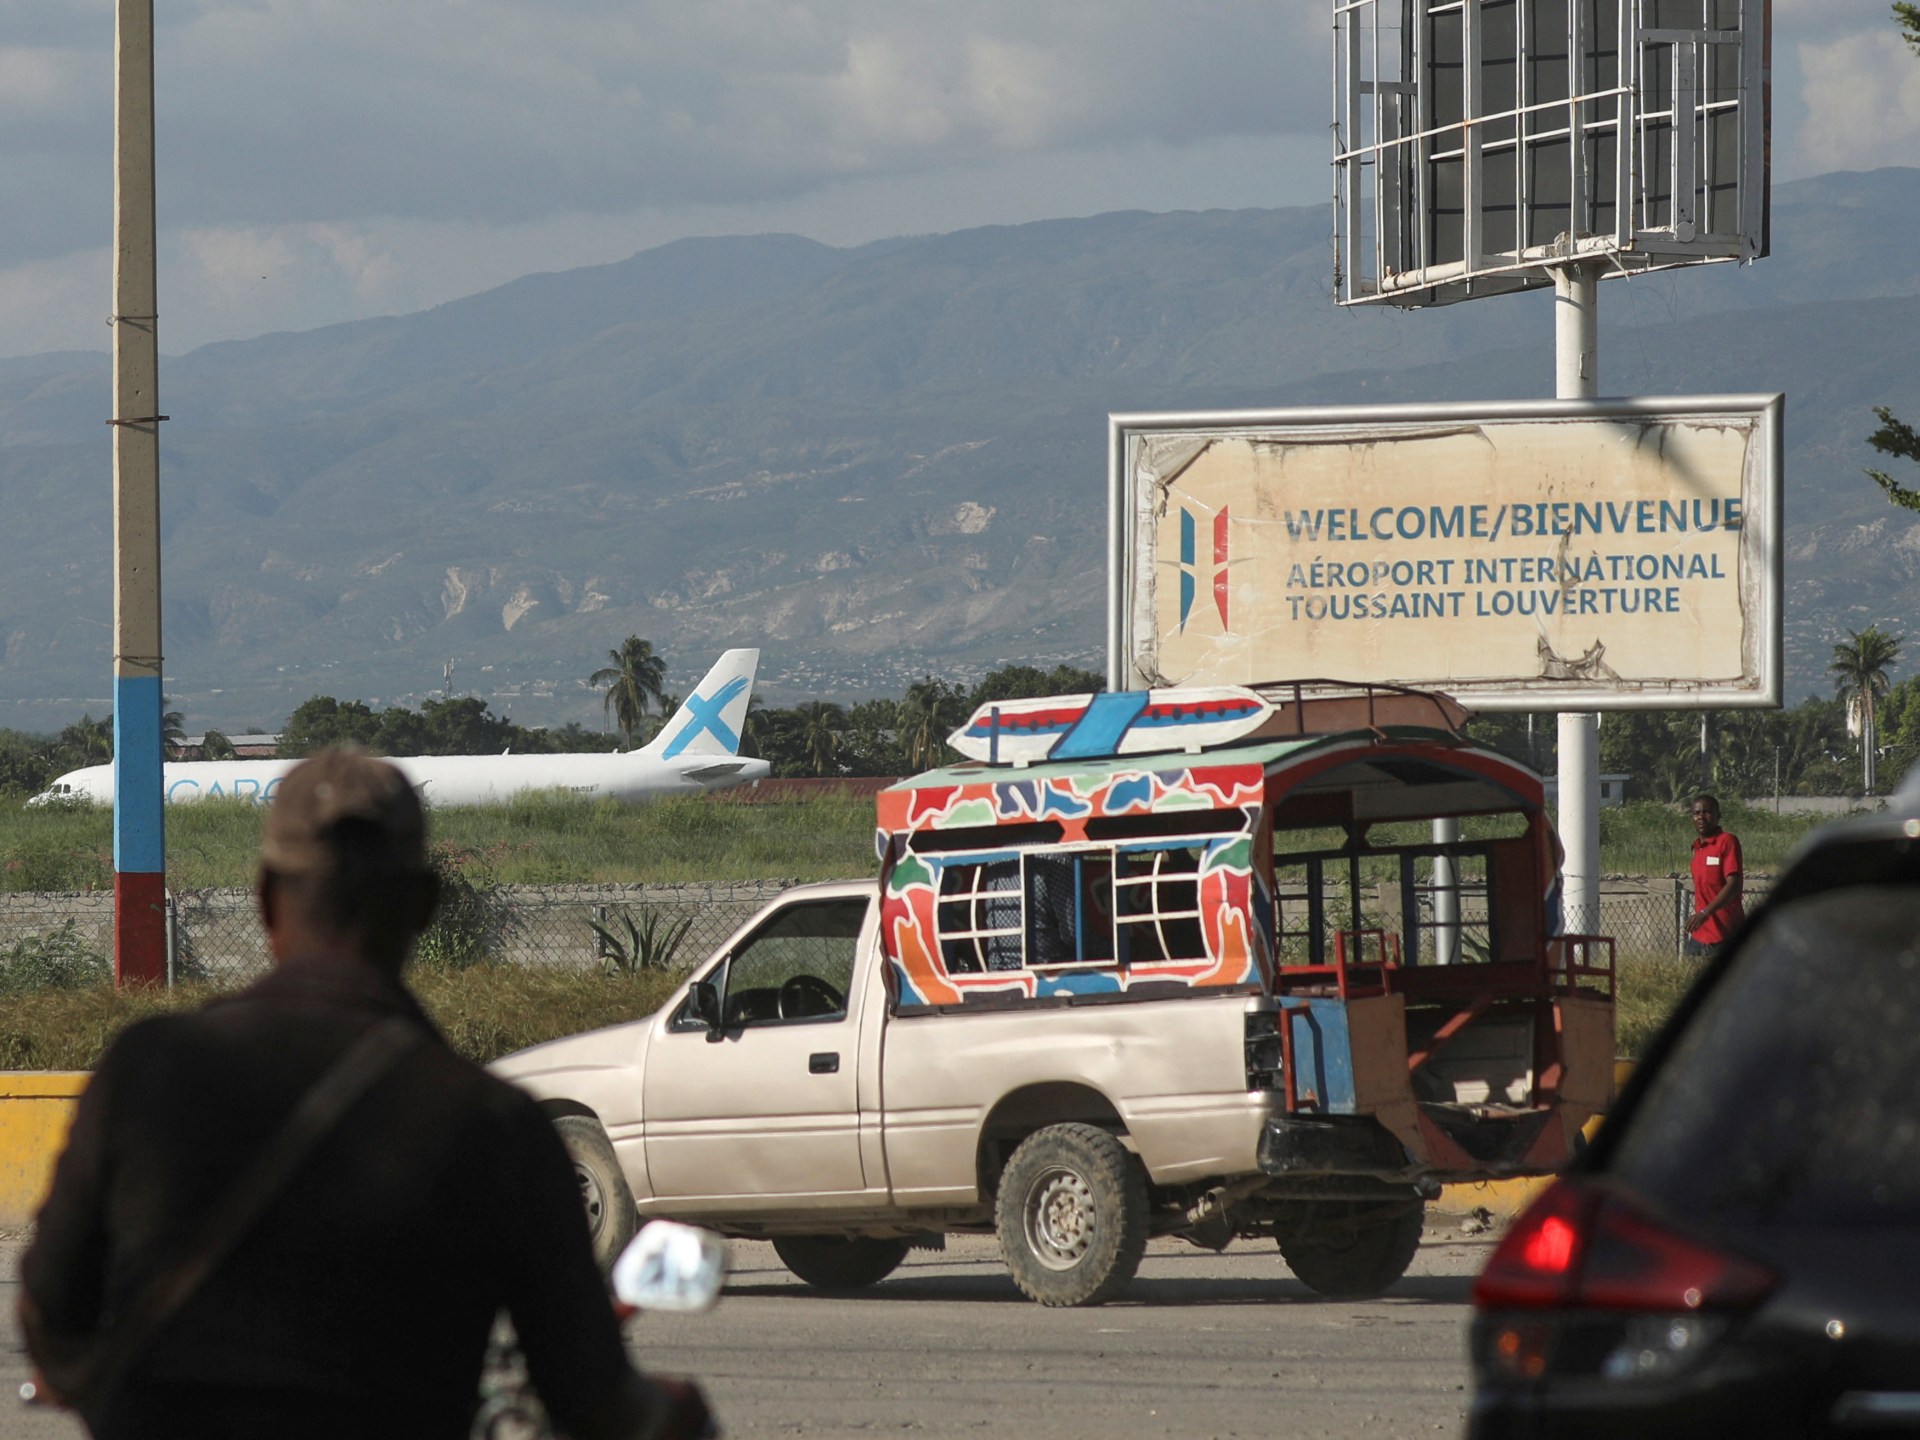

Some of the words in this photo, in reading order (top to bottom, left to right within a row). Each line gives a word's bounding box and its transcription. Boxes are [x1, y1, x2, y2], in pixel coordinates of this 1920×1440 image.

[1286, 555, 1455, 589] AÉROPORT
[1464, 553, 1726, 585] INTERNATIONAL
[1285, 592, 1466, 621] TOUSSAINT
[1476, 587, 1681, 617] LOUVERTURE
